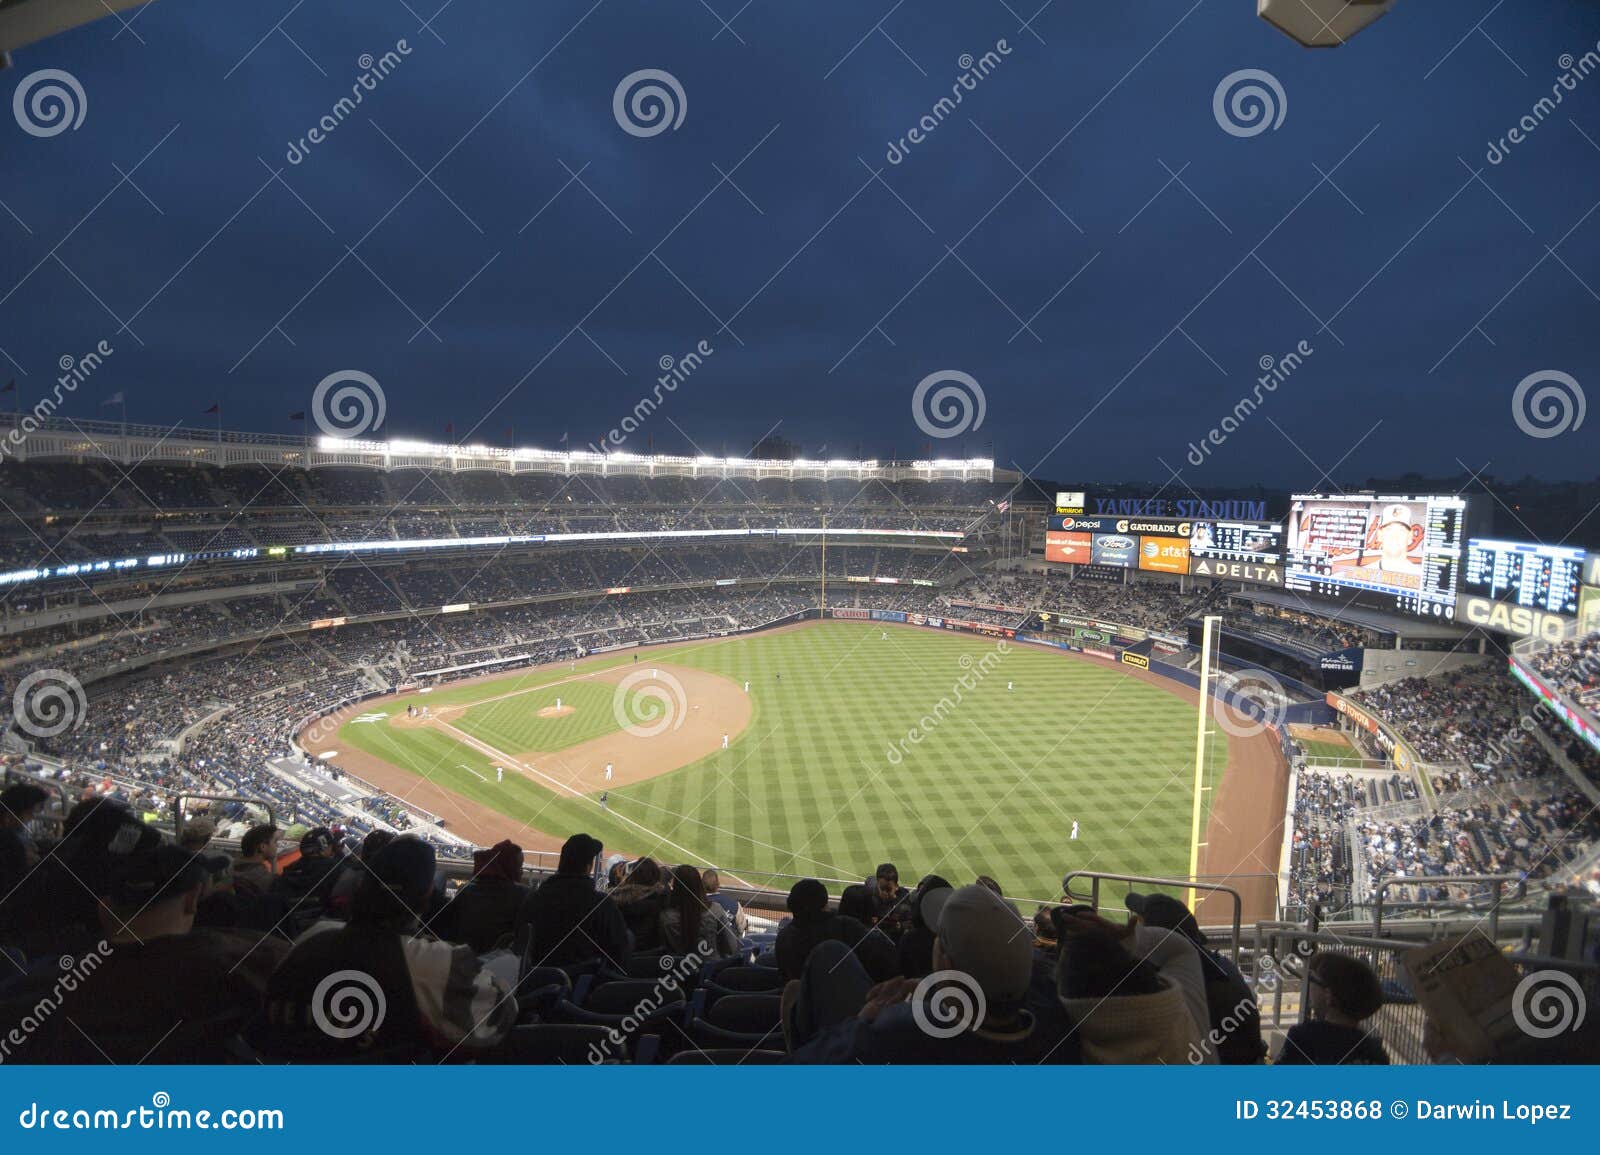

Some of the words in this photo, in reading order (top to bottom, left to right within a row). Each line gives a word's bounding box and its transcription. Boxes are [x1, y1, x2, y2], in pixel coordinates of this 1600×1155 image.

[1096, 497, 1167, 515] YANKEE
[1175, 499, 1265, 521] STADIUM
[1075, 520, 1101, 529] pepsi
[1130, 523, 1176, 533] GATORADE
[1103, 538, 1128, 549] Ford
[1160, 545, 1188, 559] at&t
[1215, 562, 1280, 583] DELTA
[1466, 598, 1565, 640] CASIO
[1346, 705, 1370, 728] TOYOTA
